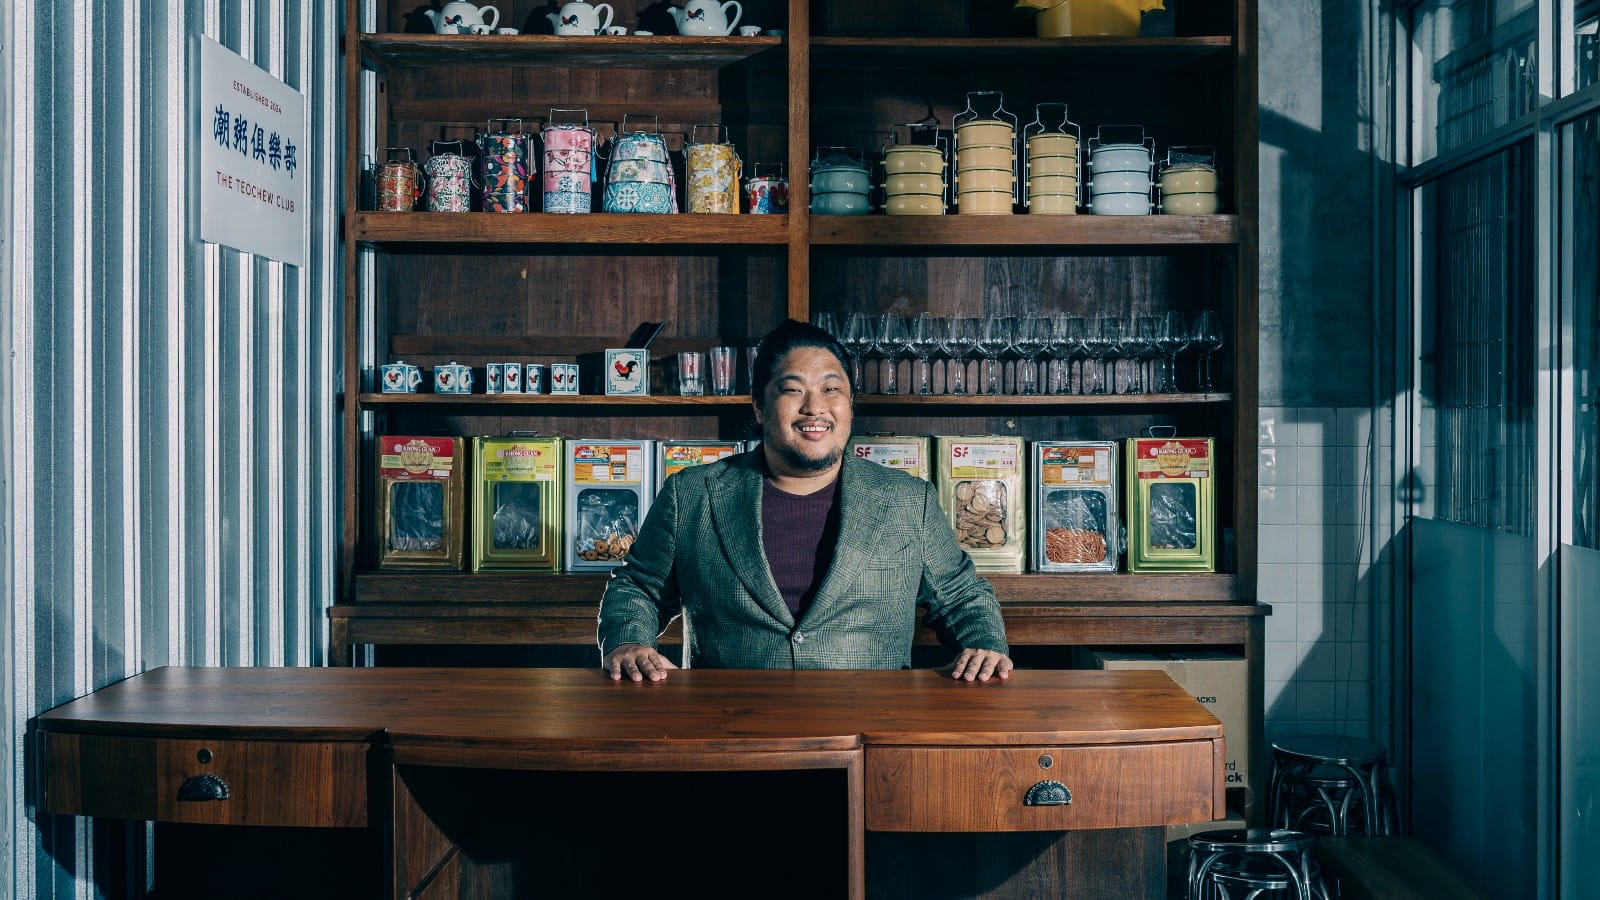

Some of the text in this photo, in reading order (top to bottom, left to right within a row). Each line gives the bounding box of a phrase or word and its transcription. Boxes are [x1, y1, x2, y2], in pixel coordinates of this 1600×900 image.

[233, 80, 269, 106] ESTABLISHED
[214, 104, 297, 179] 潮粥俱樂部
[216, 170, 295, 213] THE TEOCHEW CLUB
[1195, 696, 1217, 704] ACKS
[1225, 760, 1236, 771] rd
[1225, 772, 1243, 783] ck
